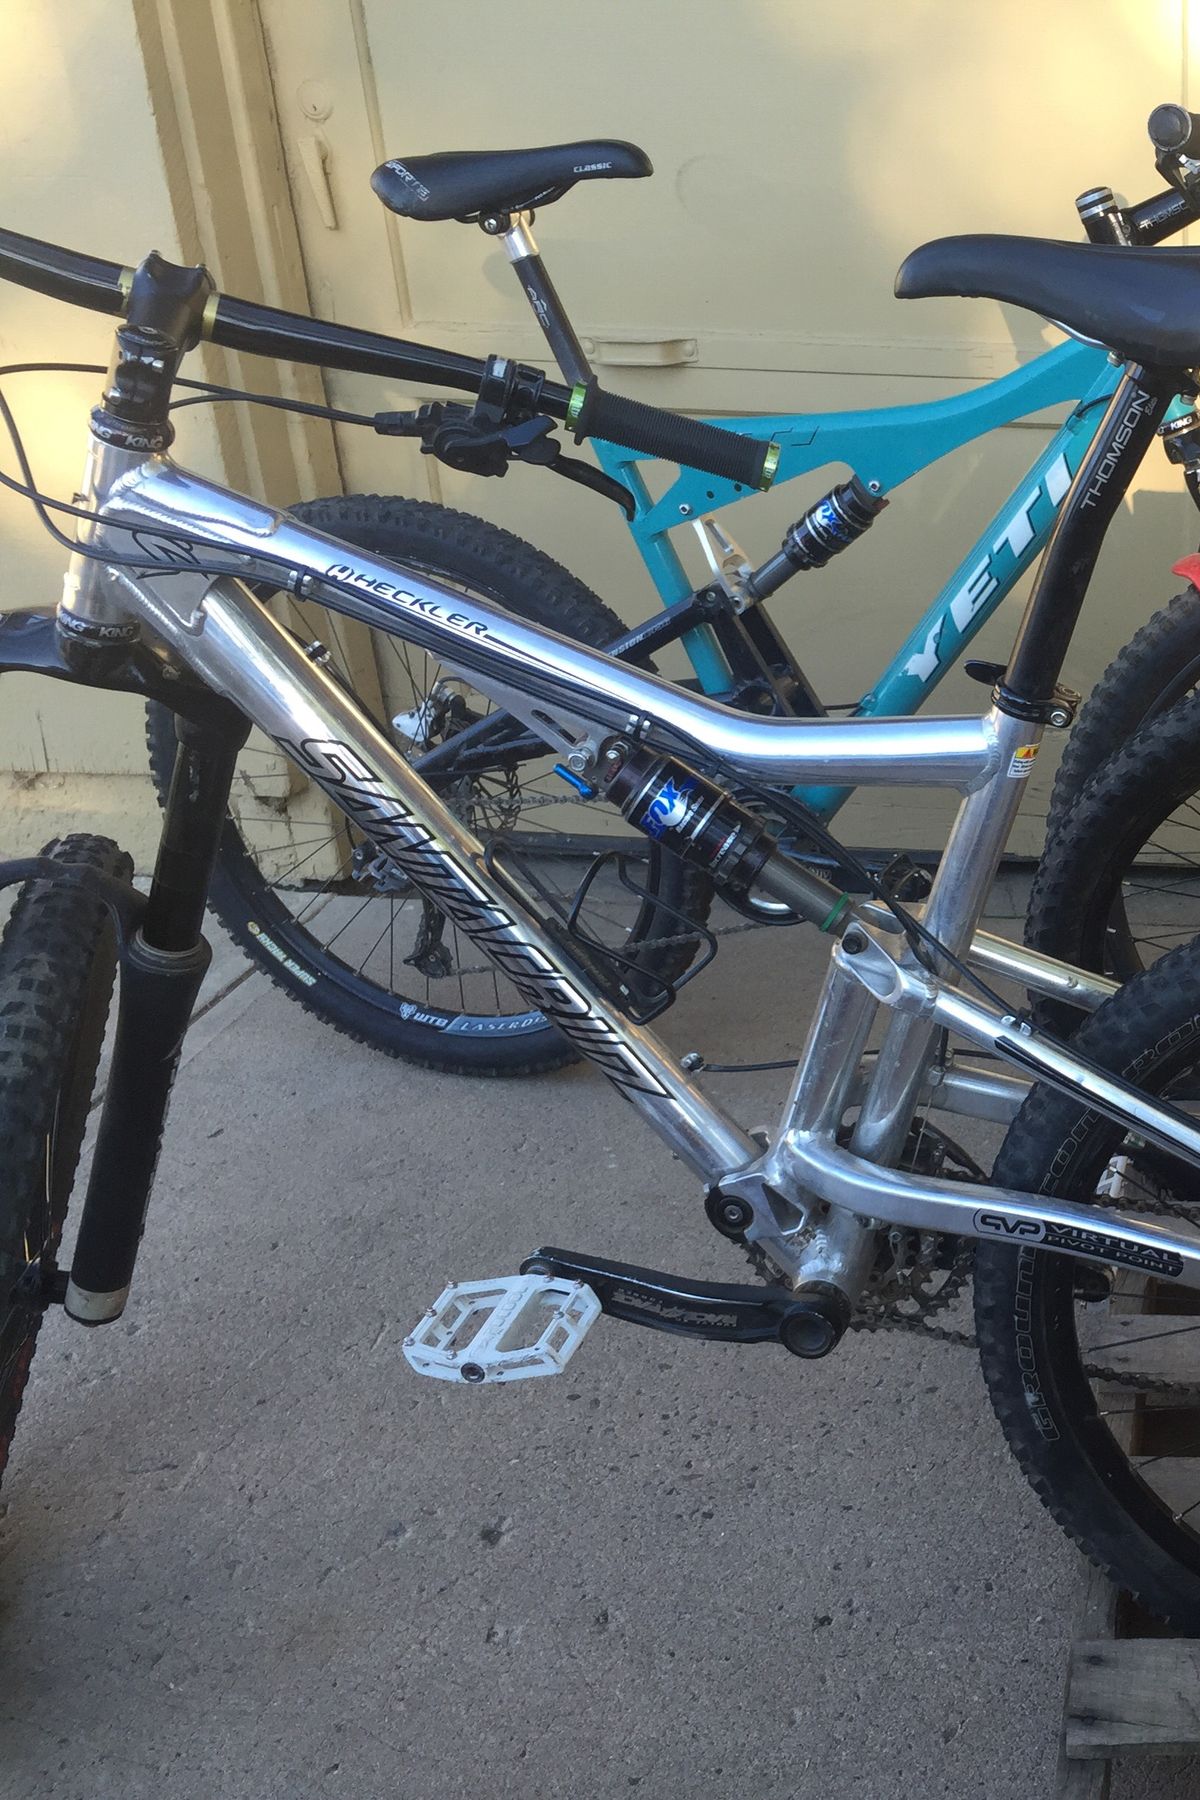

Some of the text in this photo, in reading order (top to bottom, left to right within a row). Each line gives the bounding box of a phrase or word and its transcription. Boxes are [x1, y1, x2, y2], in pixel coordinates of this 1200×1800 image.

[573, 161, 613, 173] CLASSIC
[1170, 416, 1193, 431] KING
[1080, 390, 1150, 510] THOMSON
[899, 452, 1073, 683] YETI
[354, 573, 488, 636] HECKLER
[282, 957, 317, 987] SUPER
[413, 1012, 449, 1027] WTB
[1047, 1234, 1175, 1273] PIVOT POINT
[1051, 1223, 1182, 1264] VIRTUAL
